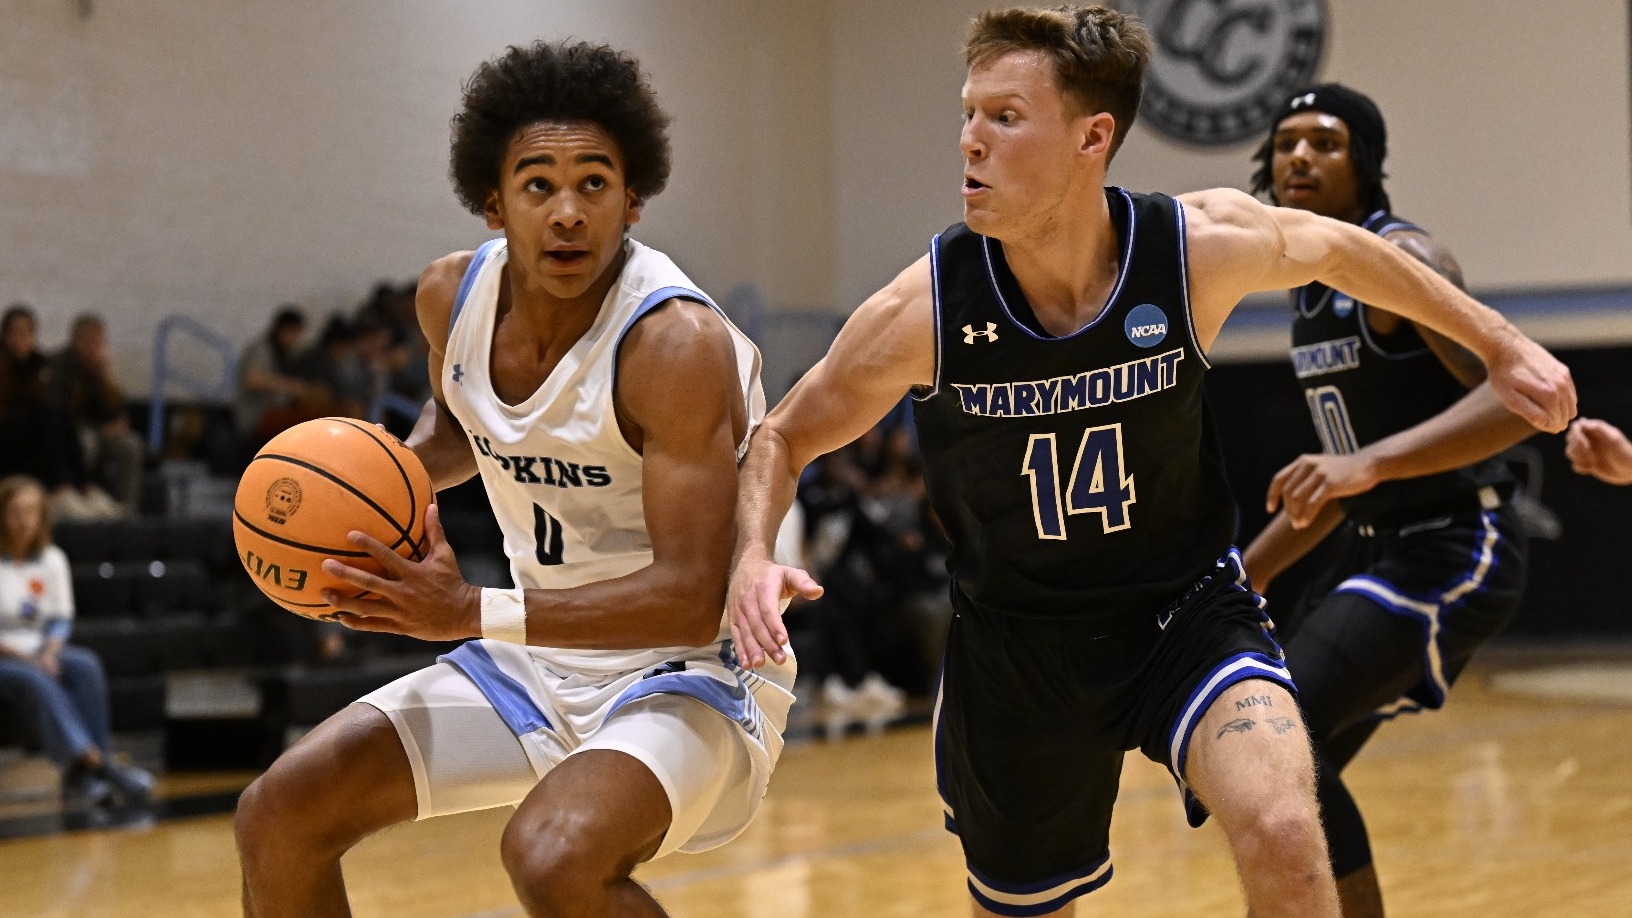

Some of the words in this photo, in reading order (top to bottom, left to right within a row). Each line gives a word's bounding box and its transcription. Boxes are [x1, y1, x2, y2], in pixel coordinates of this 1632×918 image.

[1131, 323, 1166, 339] NCAA
[950, 347, 1184, 417] MARYMOUNT
[1020, 422, 1136, 540] 14
[1236, 694, 1273, 711] MMI
